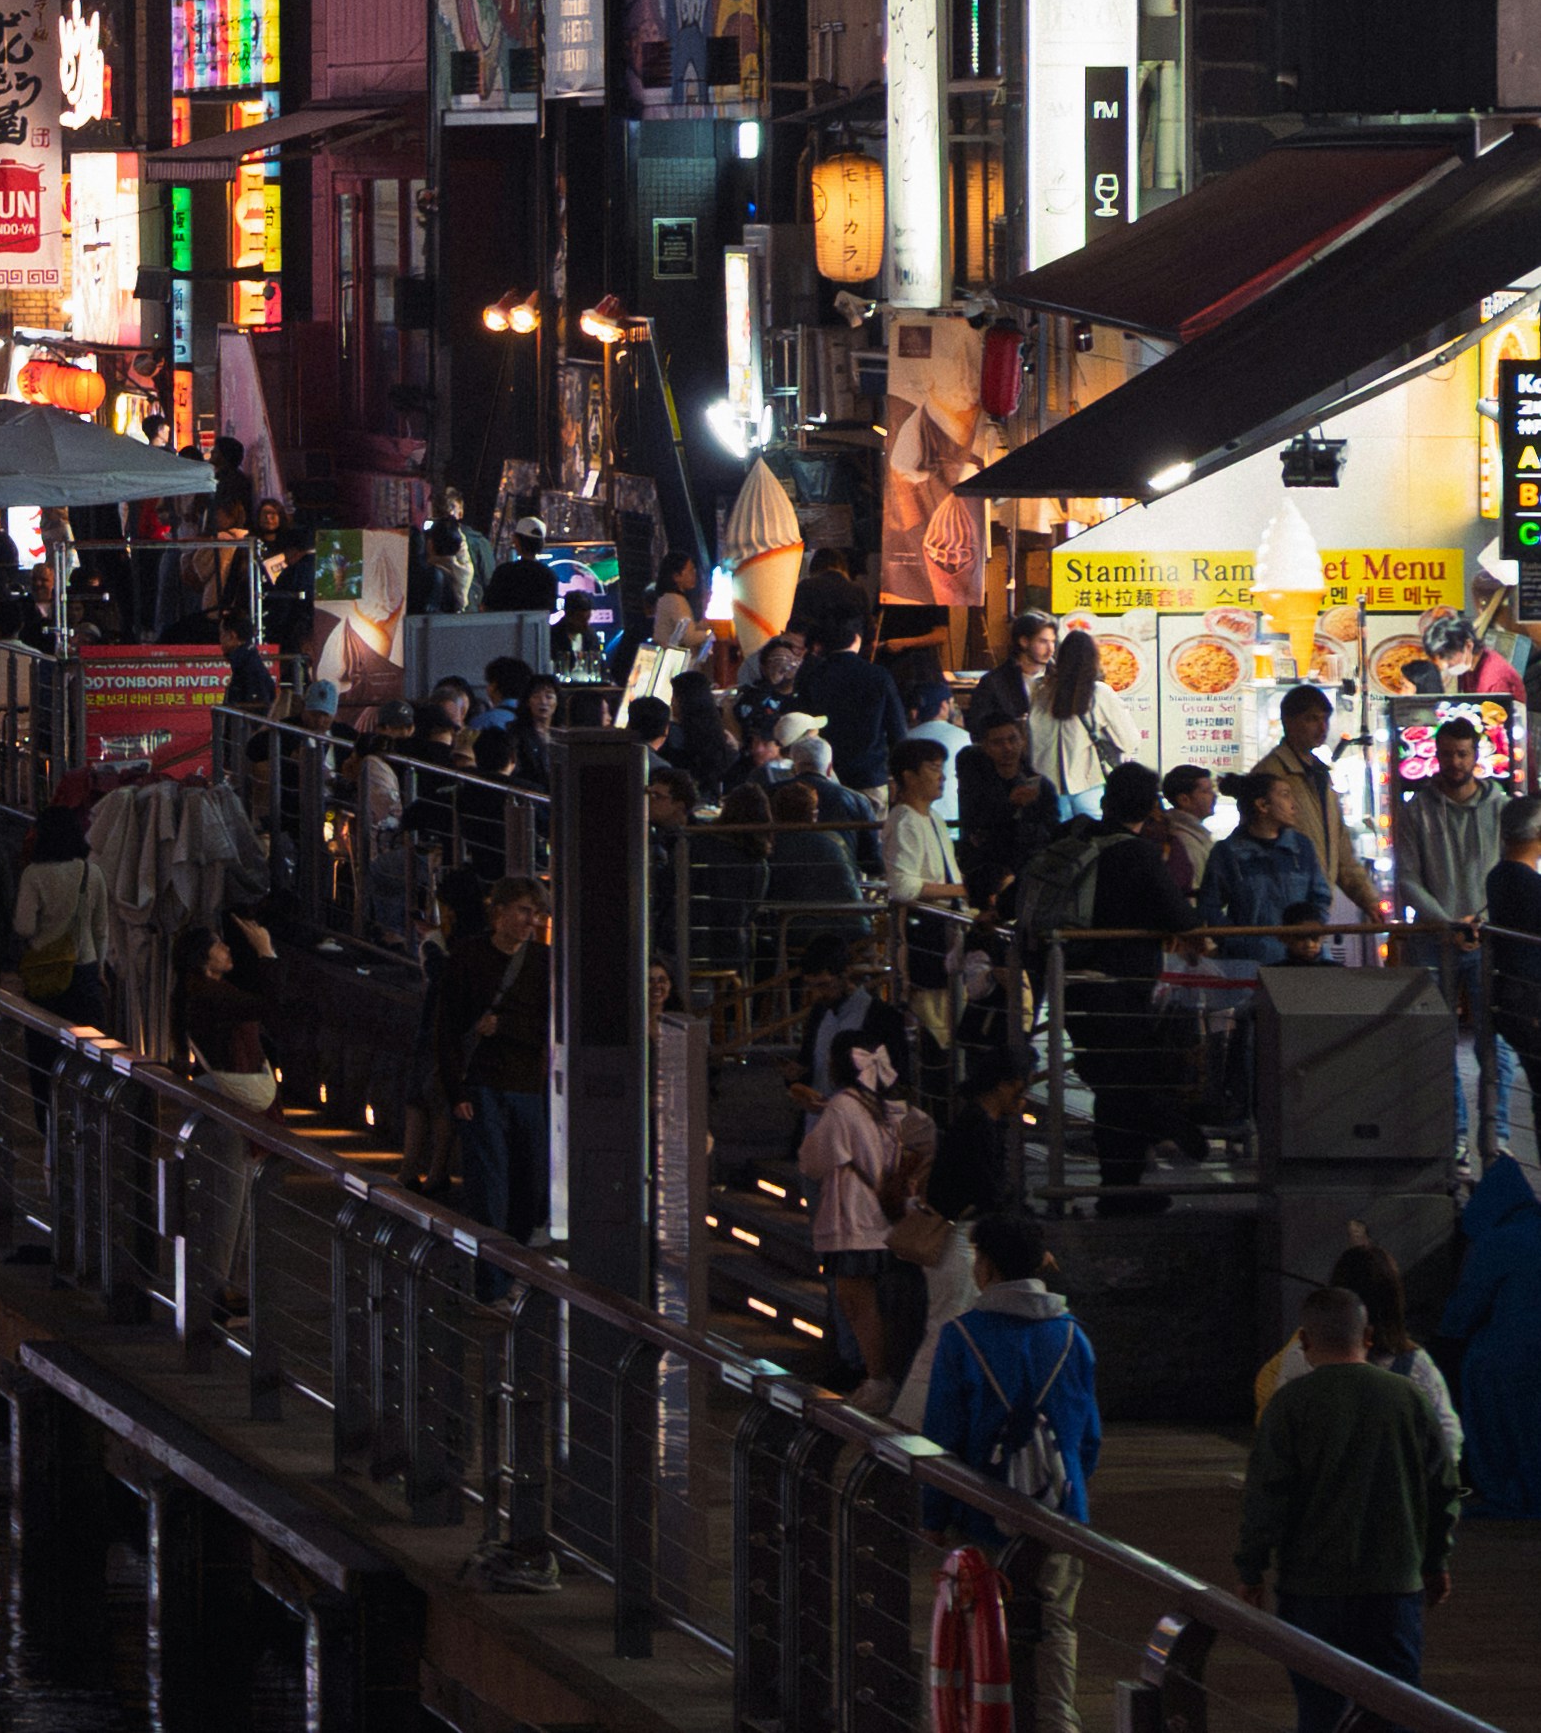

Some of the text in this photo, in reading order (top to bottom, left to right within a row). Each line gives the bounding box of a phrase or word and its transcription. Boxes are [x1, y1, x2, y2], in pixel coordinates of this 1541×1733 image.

[1066, 558, 1177, 584] Stamina
[1323, 557, 1348, 582] et
[1362, 554, 1446, 582] Menu
[1402, 585, 1444, 605] 메뉴
[175, 675, 219, 688] RIVER
